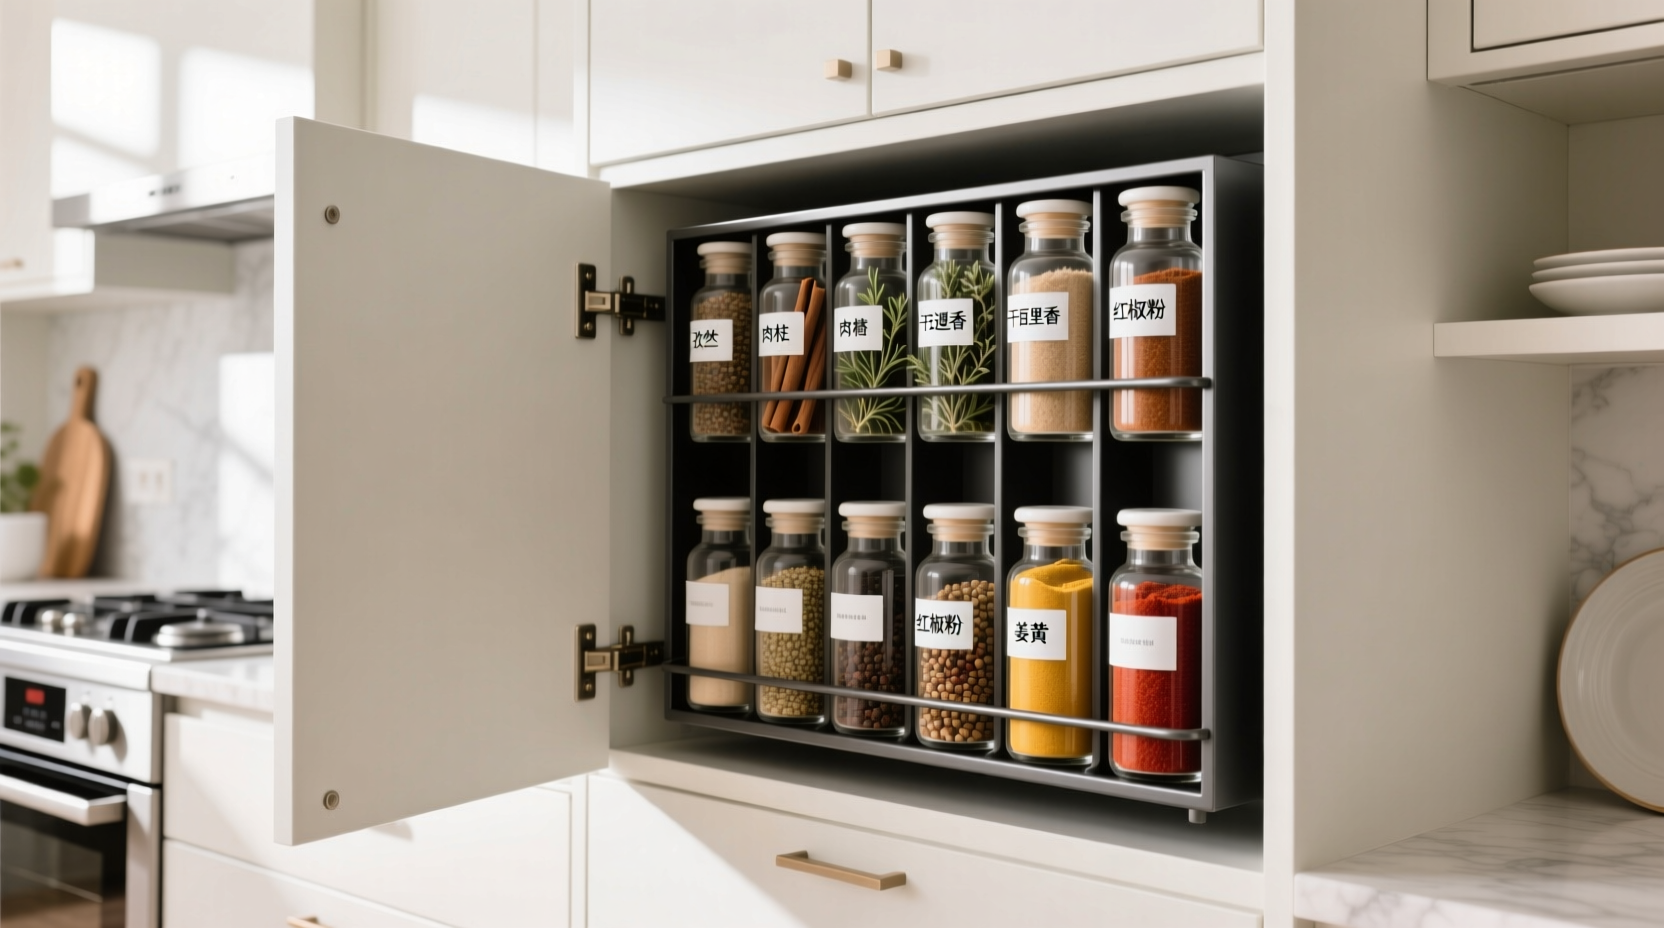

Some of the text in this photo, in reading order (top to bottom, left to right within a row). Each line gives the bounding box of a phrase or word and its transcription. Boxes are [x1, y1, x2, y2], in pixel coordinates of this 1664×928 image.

[1113, 298, 1166, 320] 红椒粉
[916, 613, 964, 635] 红椒粉
[1014, 621, 1050, 644] 姜黄
